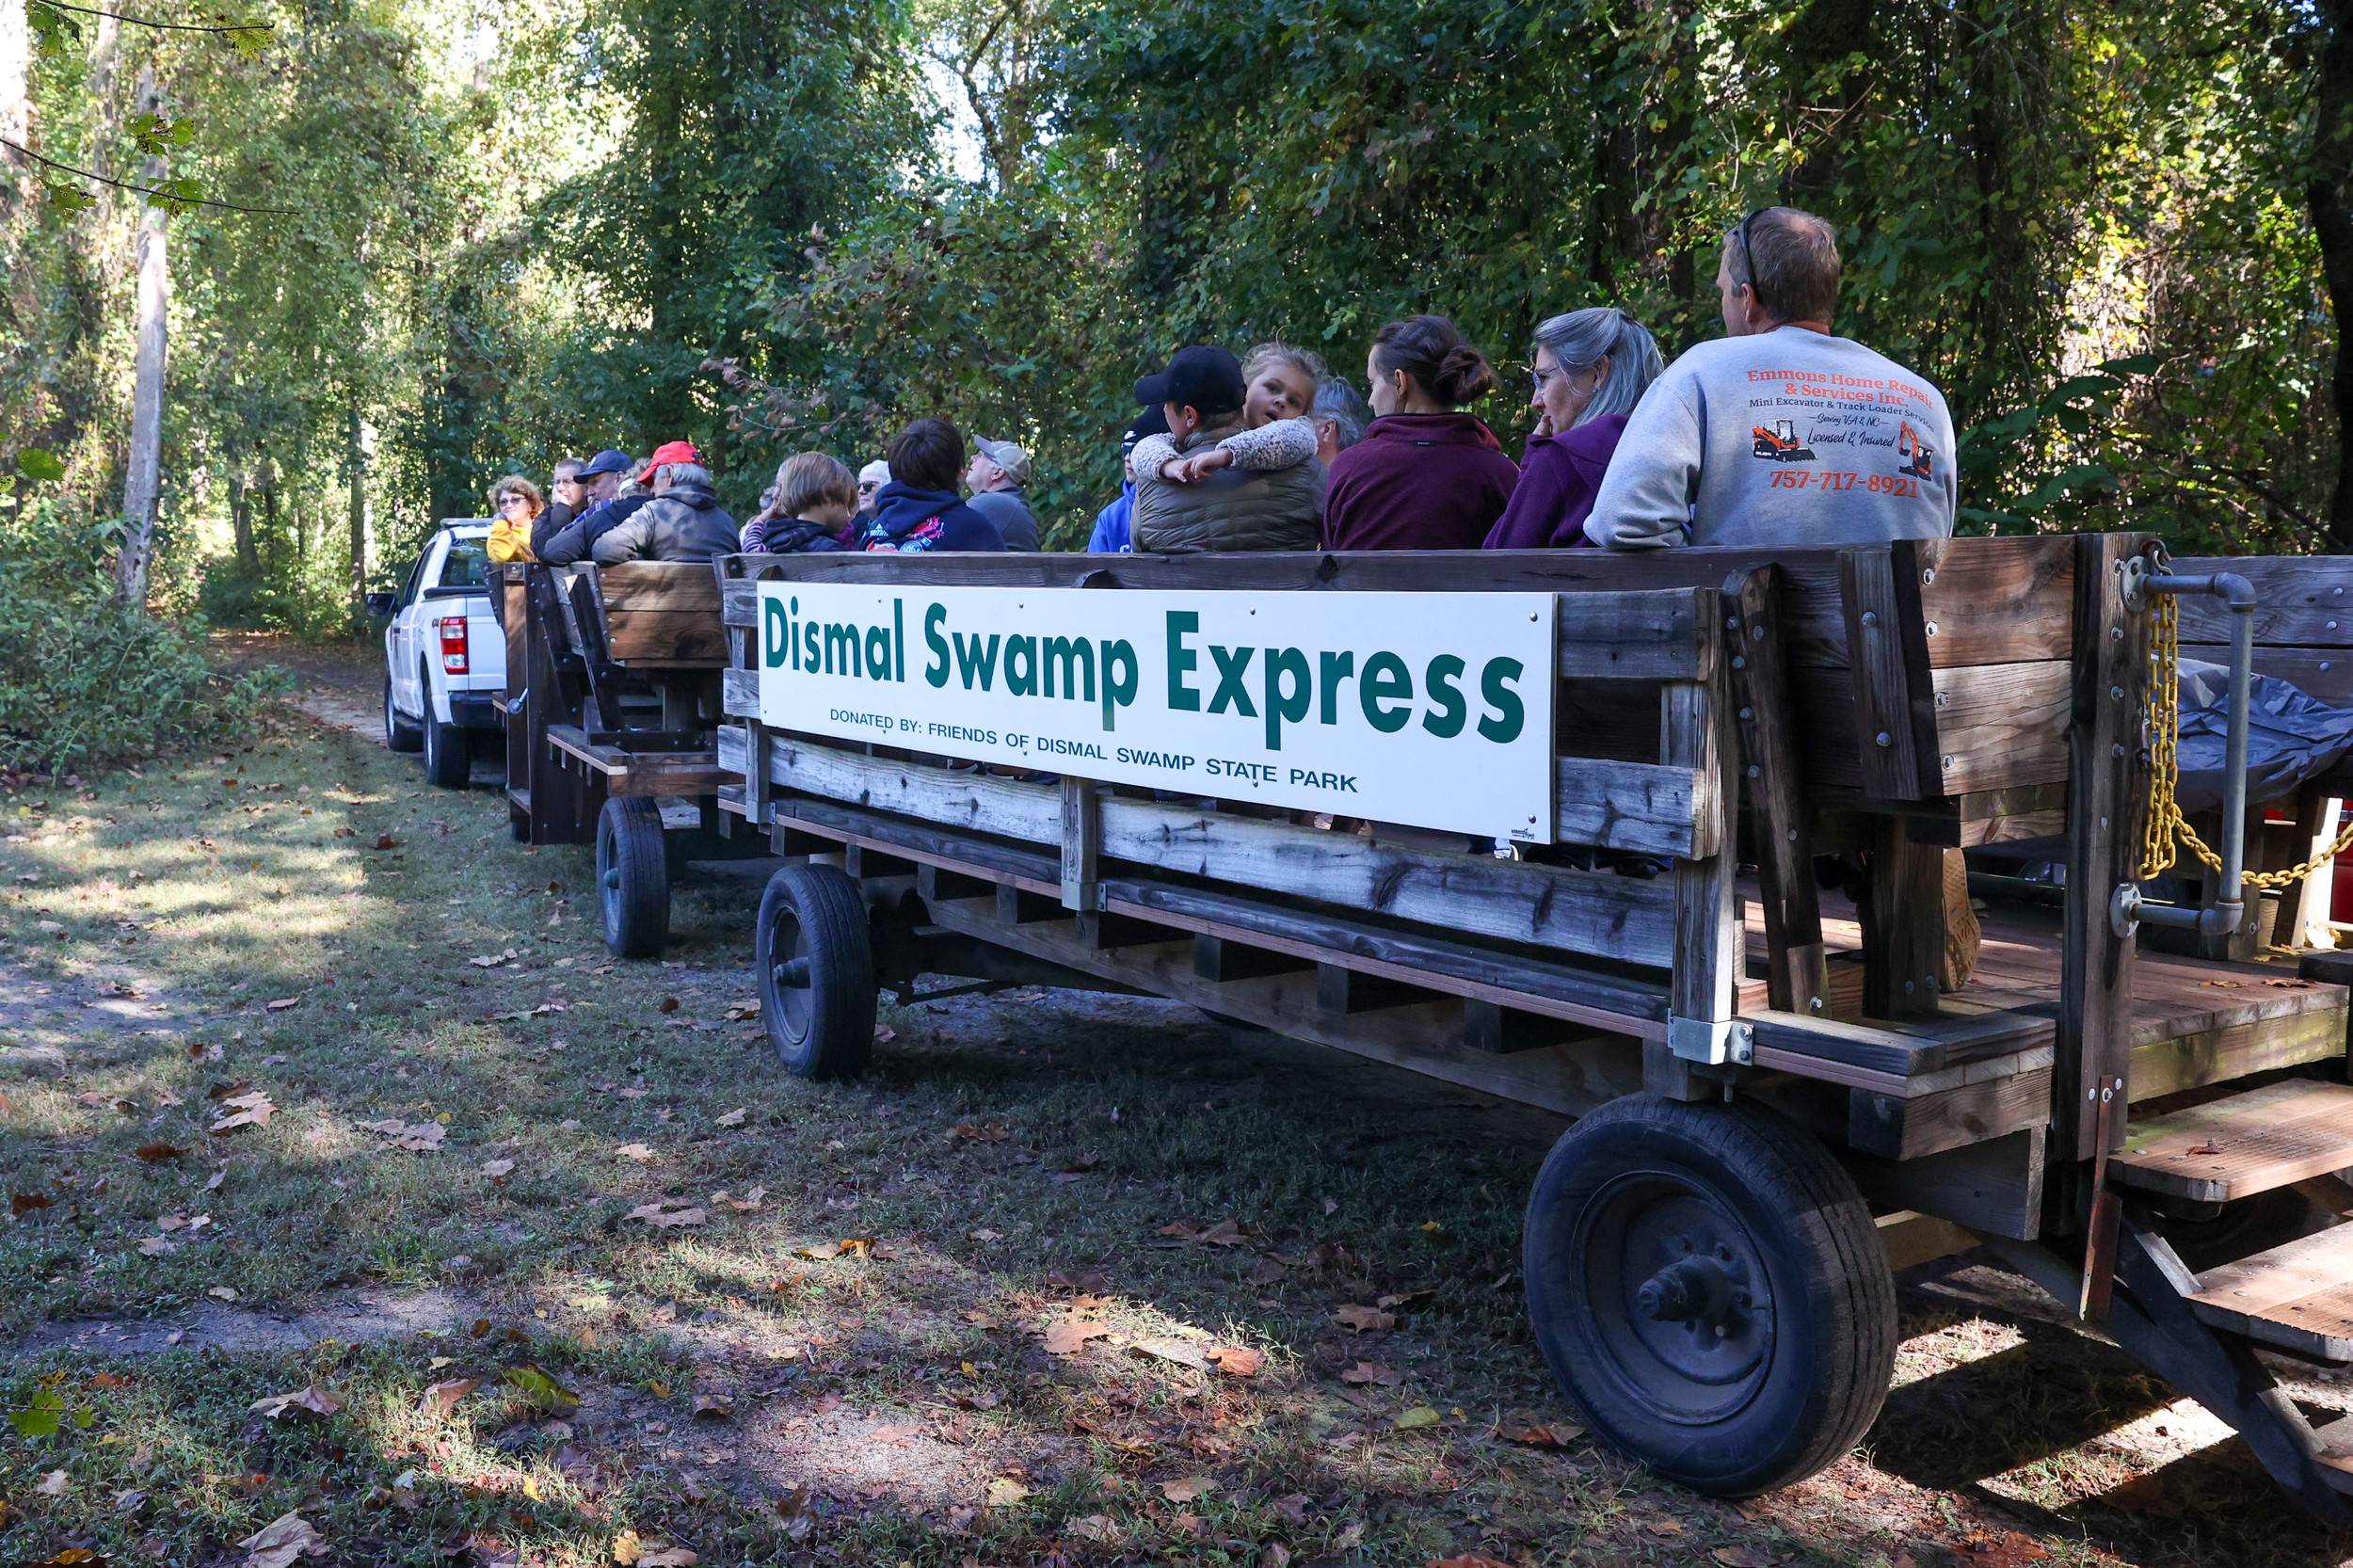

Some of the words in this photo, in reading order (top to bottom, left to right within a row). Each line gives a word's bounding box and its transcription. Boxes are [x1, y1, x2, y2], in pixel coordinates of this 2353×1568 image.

[1747, 370, 1827, 383] Emmons
[1832, 374, 1883, 389] Home
[1889, 380, 1933, 408] Repair
[1785, 383, 1799, 395] &
[1801, 384, 1874, 402] Services
[1879, 392, 1909, 408] Inc.
[1750, 397, 1773, 408] Mini
[1776, 397, 1824, 408] Excavator
[1827, 400, 1834, 409] &
[1838, 402, 1865, 411] Track
[1868, 404, 1902, 416] Loader
[1807, 427, 1845, 444] Licensed
[1859, 432, 1896, 447] Insured
[1770, 471, 1917, 498] 757-717-8921
[764, 596, 904, 682] Dismal
[924, 602, 1138, 732] Swamp
[1166, 610, 1525, 751] Express
[830, 708, 893, 729] DONATED
[901, 718, 921, 733] BY:
[928, 722, 998, 744] FRIENDS
[1005, 733, 1029, 748] OF
[1037, 737, 1108, 760] DISMAL
[1117, 747, 1195, 771] SWAMP
[1207, 758, 1277, 783] STATE
[1289, 769, 1358, 793] PARK
